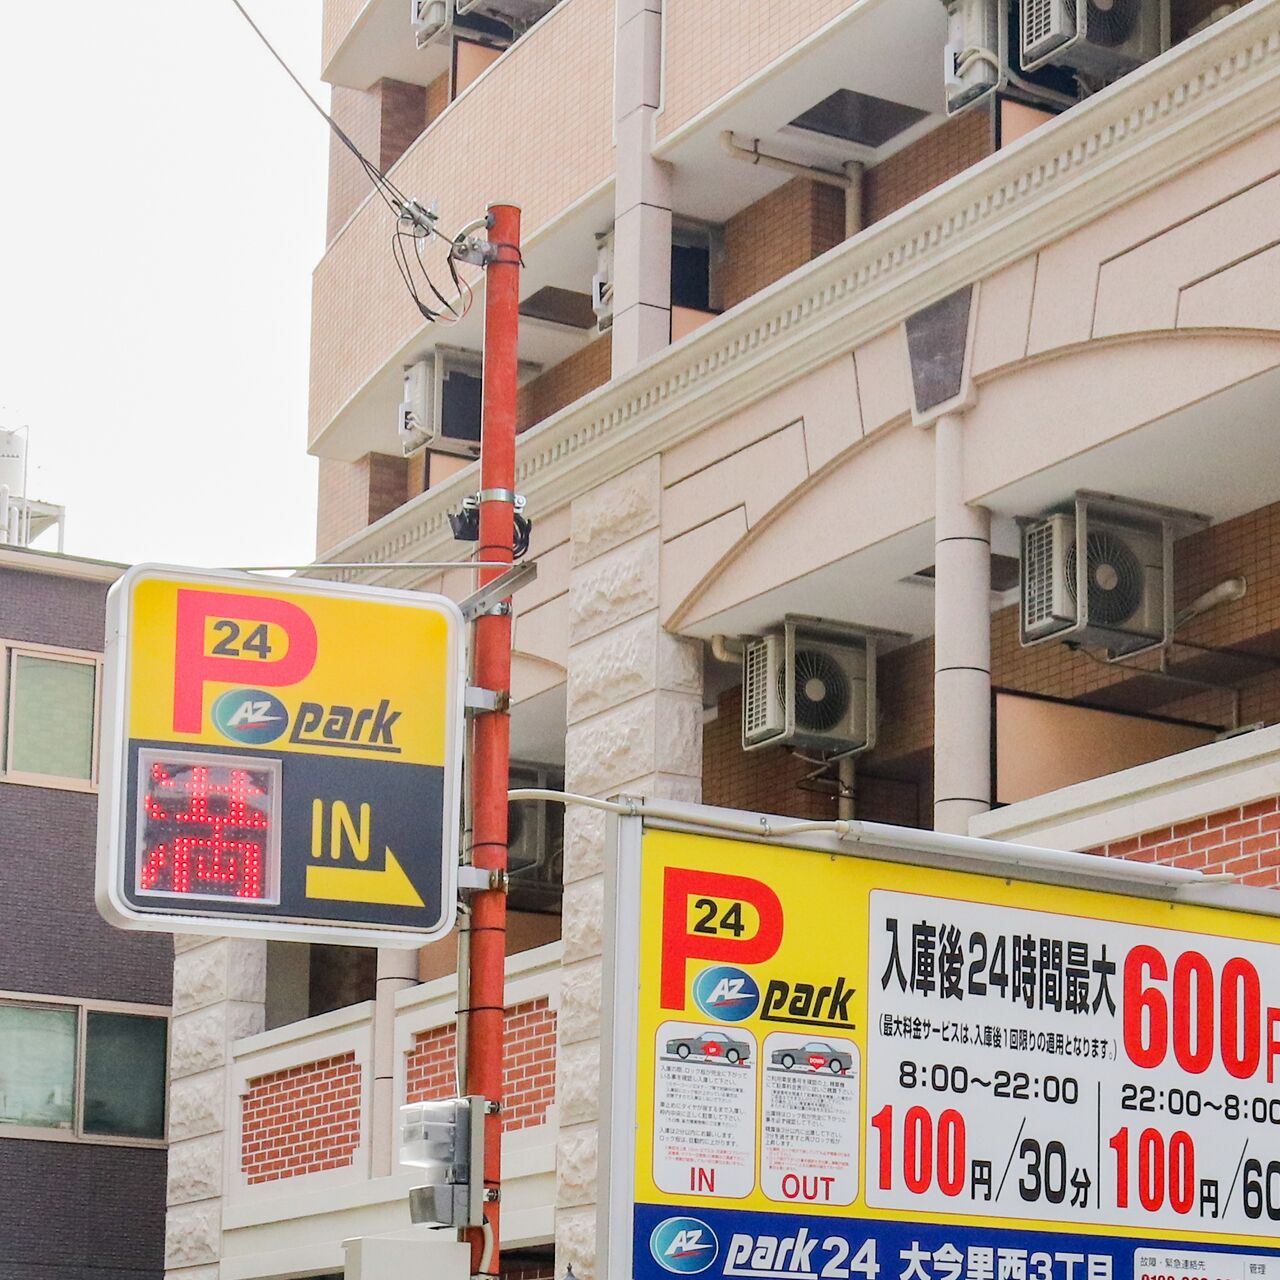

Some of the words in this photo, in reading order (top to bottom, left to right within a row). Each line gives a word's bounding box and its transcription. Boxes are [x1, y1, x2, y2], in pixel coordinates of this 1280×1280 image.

[173, 589, 318, 734] P
[212, 620, 271, 659] 24
[289, 699, 402, 753] park
[311, 798, 371, 862] IN
[660, 866, 784, 1011] P
[693, 898, 745, 937] 24
[881, 918, 1117, 1017] 入庫後24時間最大
[760, 976, 856, 1030] park
[690, 1167, 715, 1193] IN
[781, 1173, 836, 1201] OUT
[1249, 1263, 1266, 1275] 管理
